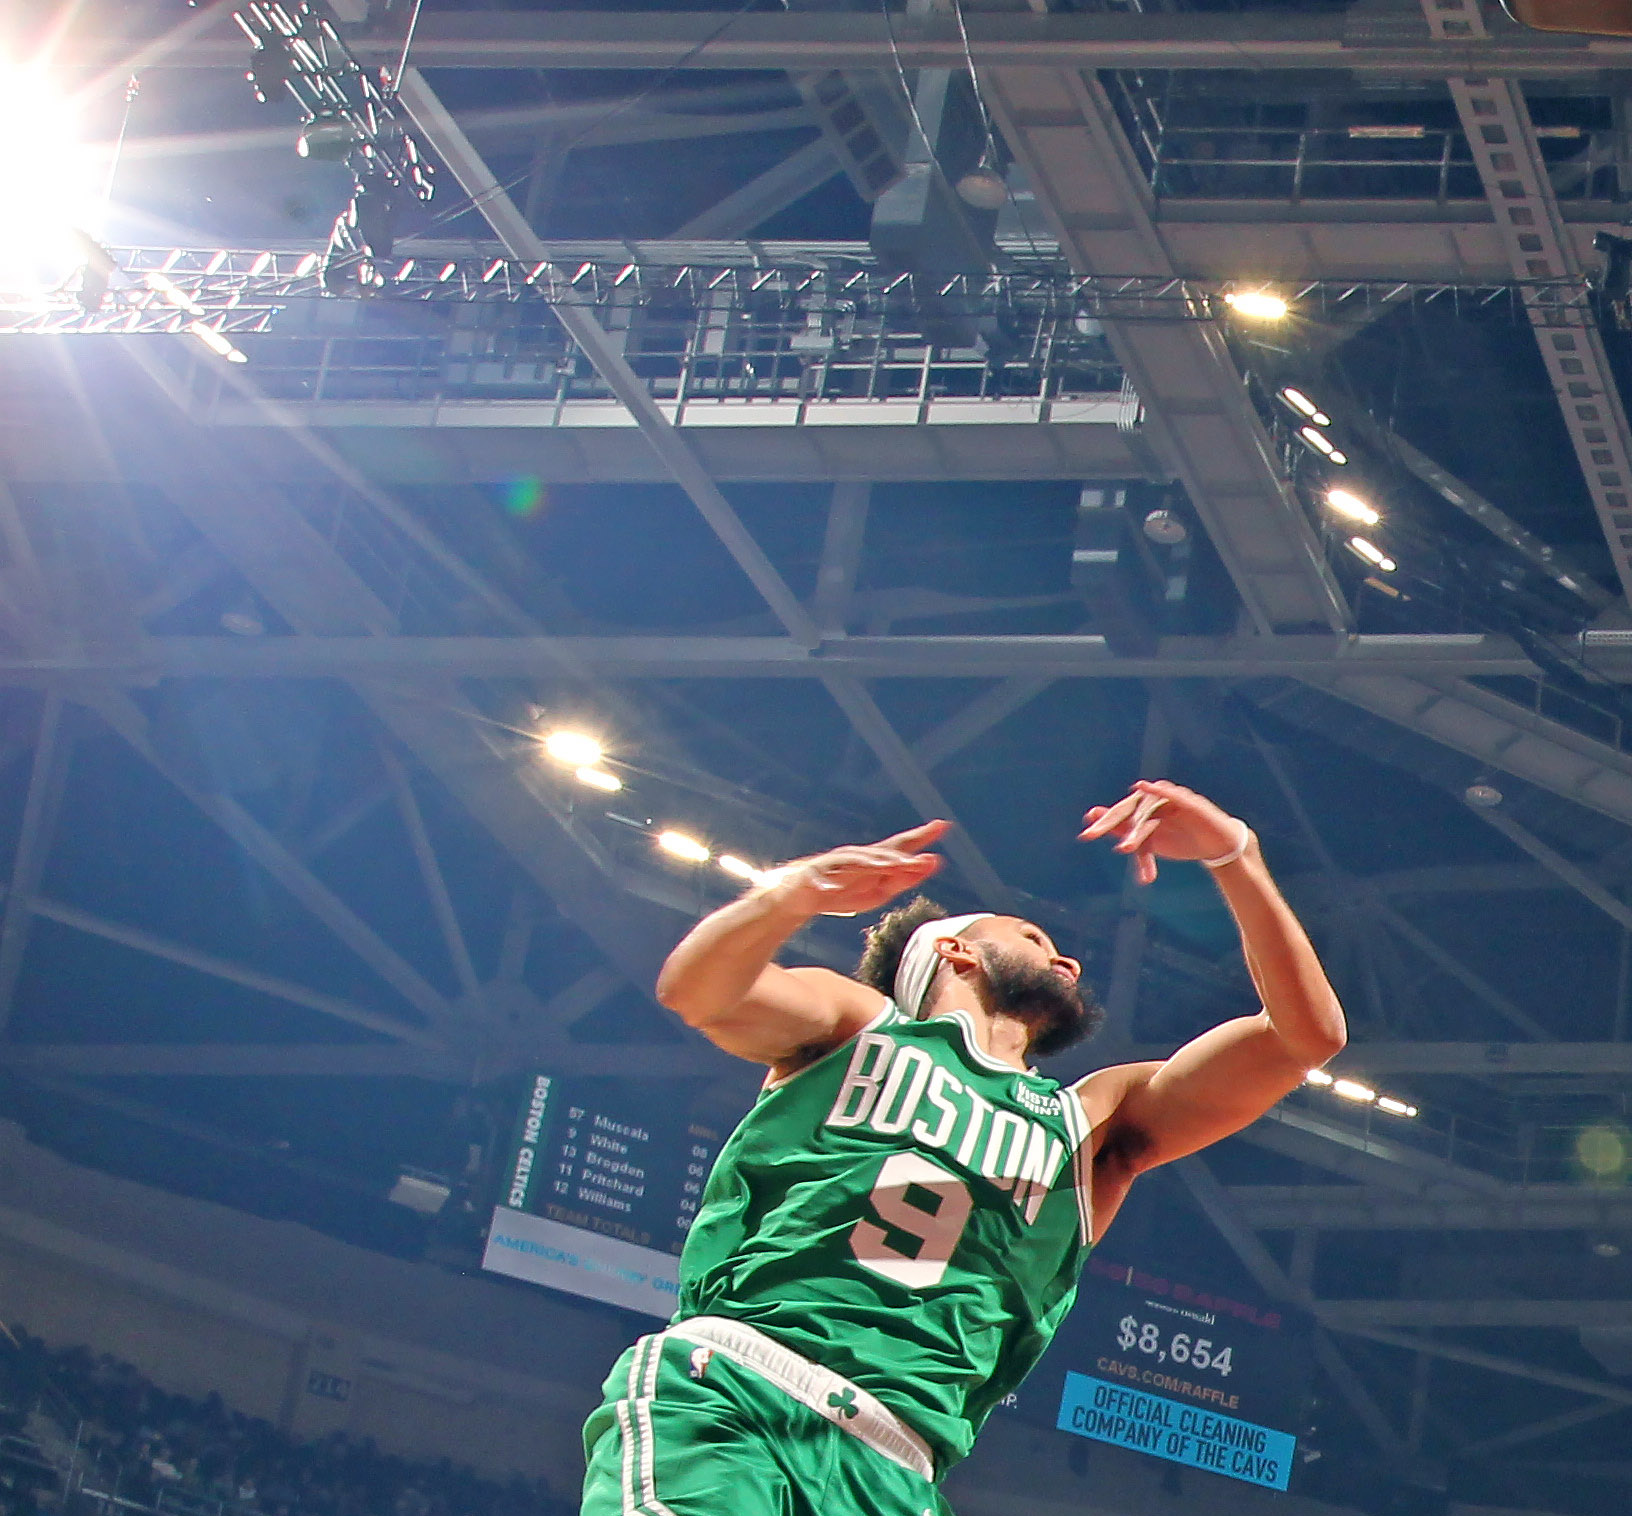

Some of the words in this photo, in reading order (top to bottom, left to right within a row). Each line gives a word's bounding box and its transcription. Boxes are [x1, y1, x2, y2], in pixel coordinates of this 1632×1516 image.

[524, 1075, 551, 1144] BOSTON
[1016, 1081, 1062, 1110] VISTA
[590, 1133, 629, 1155] White
[593, 1115, 650, 1143] Muscala
[825, 1032, 1065, 1226] BOSTON
[507, 1147, 535, 1208] CELTICS
[559, 1163, 573, 1177] 11
[582, 1168, 646, 1198] Pritchard
[586, 1151, 646, 1180] Brogdon
[553, 1180, 570, 1195] 12
[578, 1186, 633, 1213] Williams
[849, 1151, 974, 1290] 9
[1116, 1315, 1233, 1378] $8,654
[1097, 1357, 1240, 1410] CAVS.COM/RAFFLE
[1072, 1404, 1162, 1451] COMPANY
[1165, 1431, 1187, 1456] OF
[1196, 1438, 1226, 1470] THE
[1232, 1450, 1278, 1483] CAVS
[1094, 1385, 1173, 1428] OFFICIAL
[1179, 1409, 1267, 1454] CLEANING
